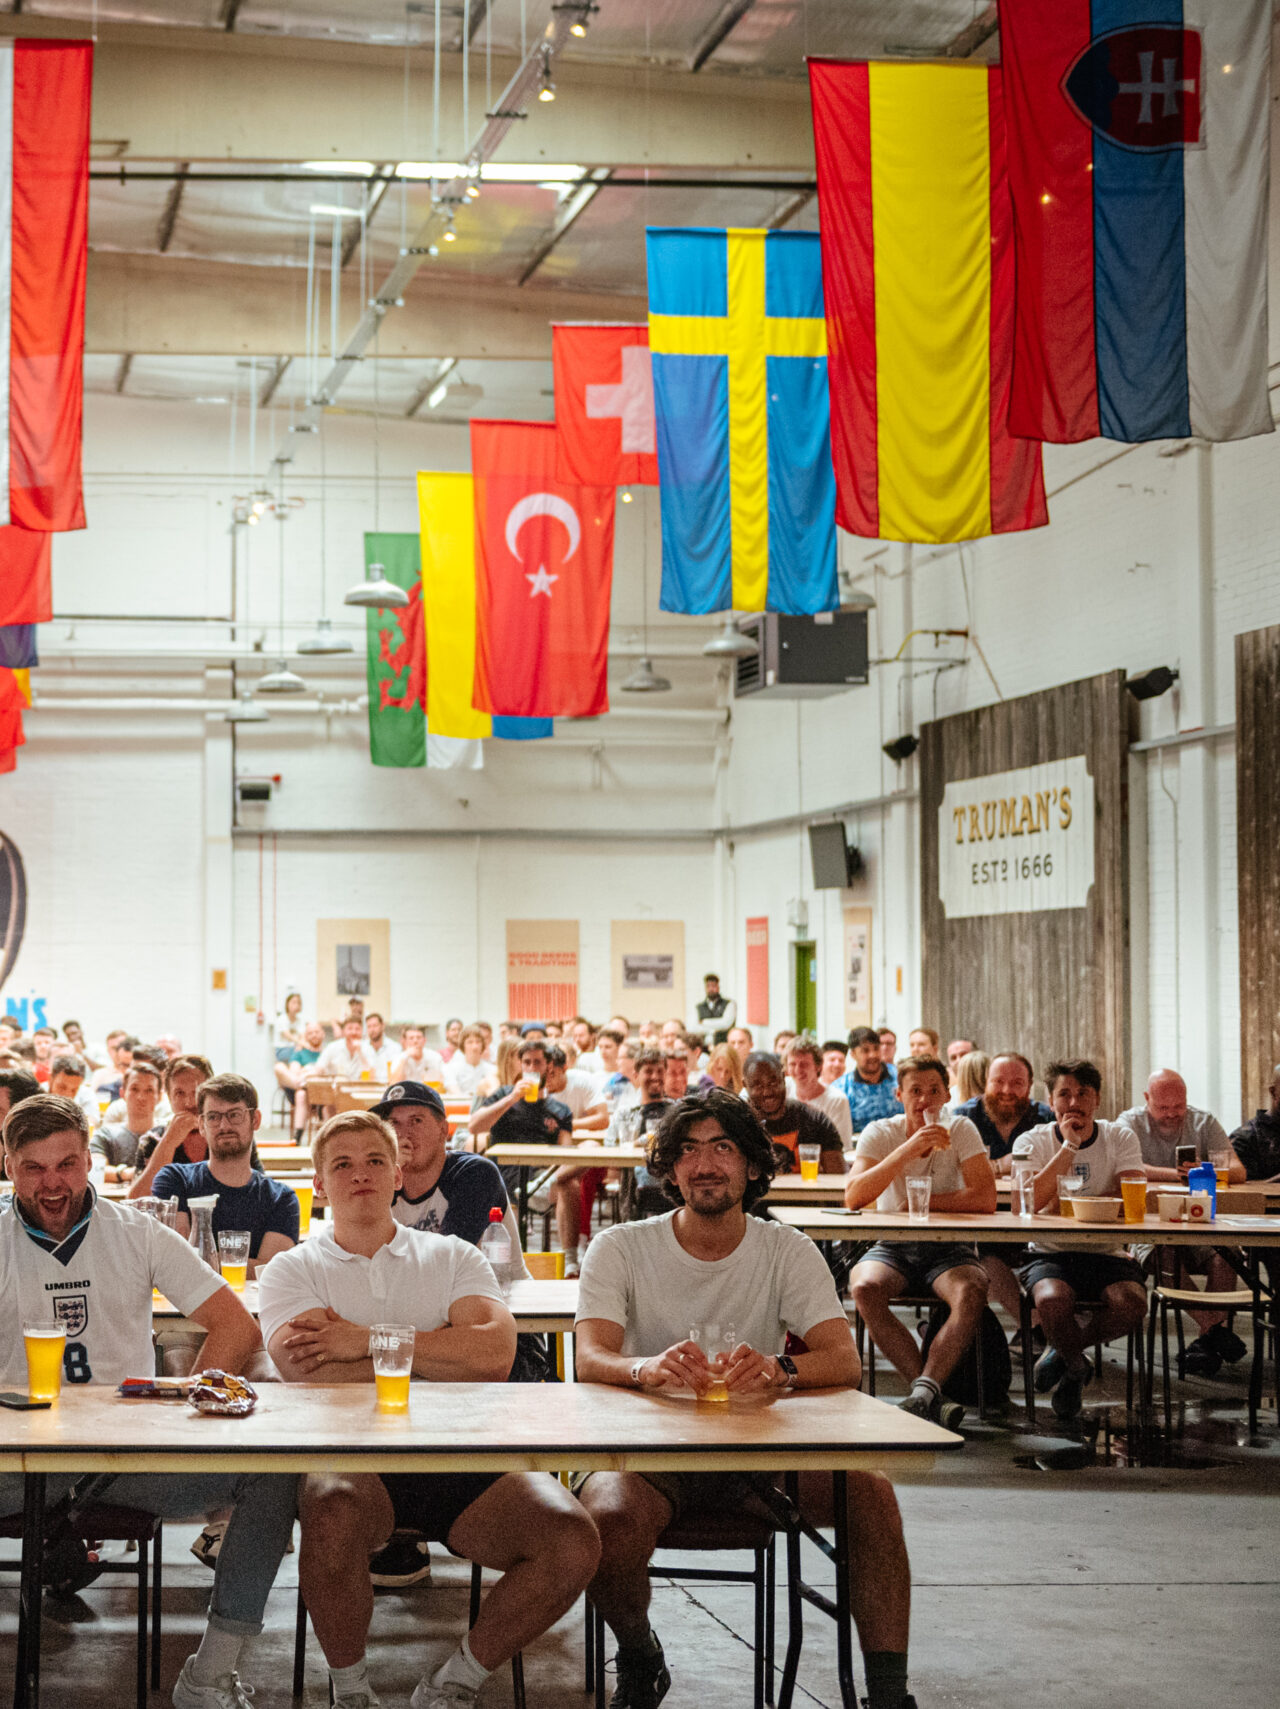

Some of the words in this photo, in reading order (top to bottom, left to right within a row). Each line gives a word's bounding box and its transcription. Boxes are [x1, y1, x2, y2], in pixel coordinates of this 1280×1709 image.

[953, 786, 1072, 844] TRUMAN'S
[1014, 853, 1053, 880] 1666
[45, 1279, 91, 1291] UMBRO
[63, 1342, 93, 1384] 8
